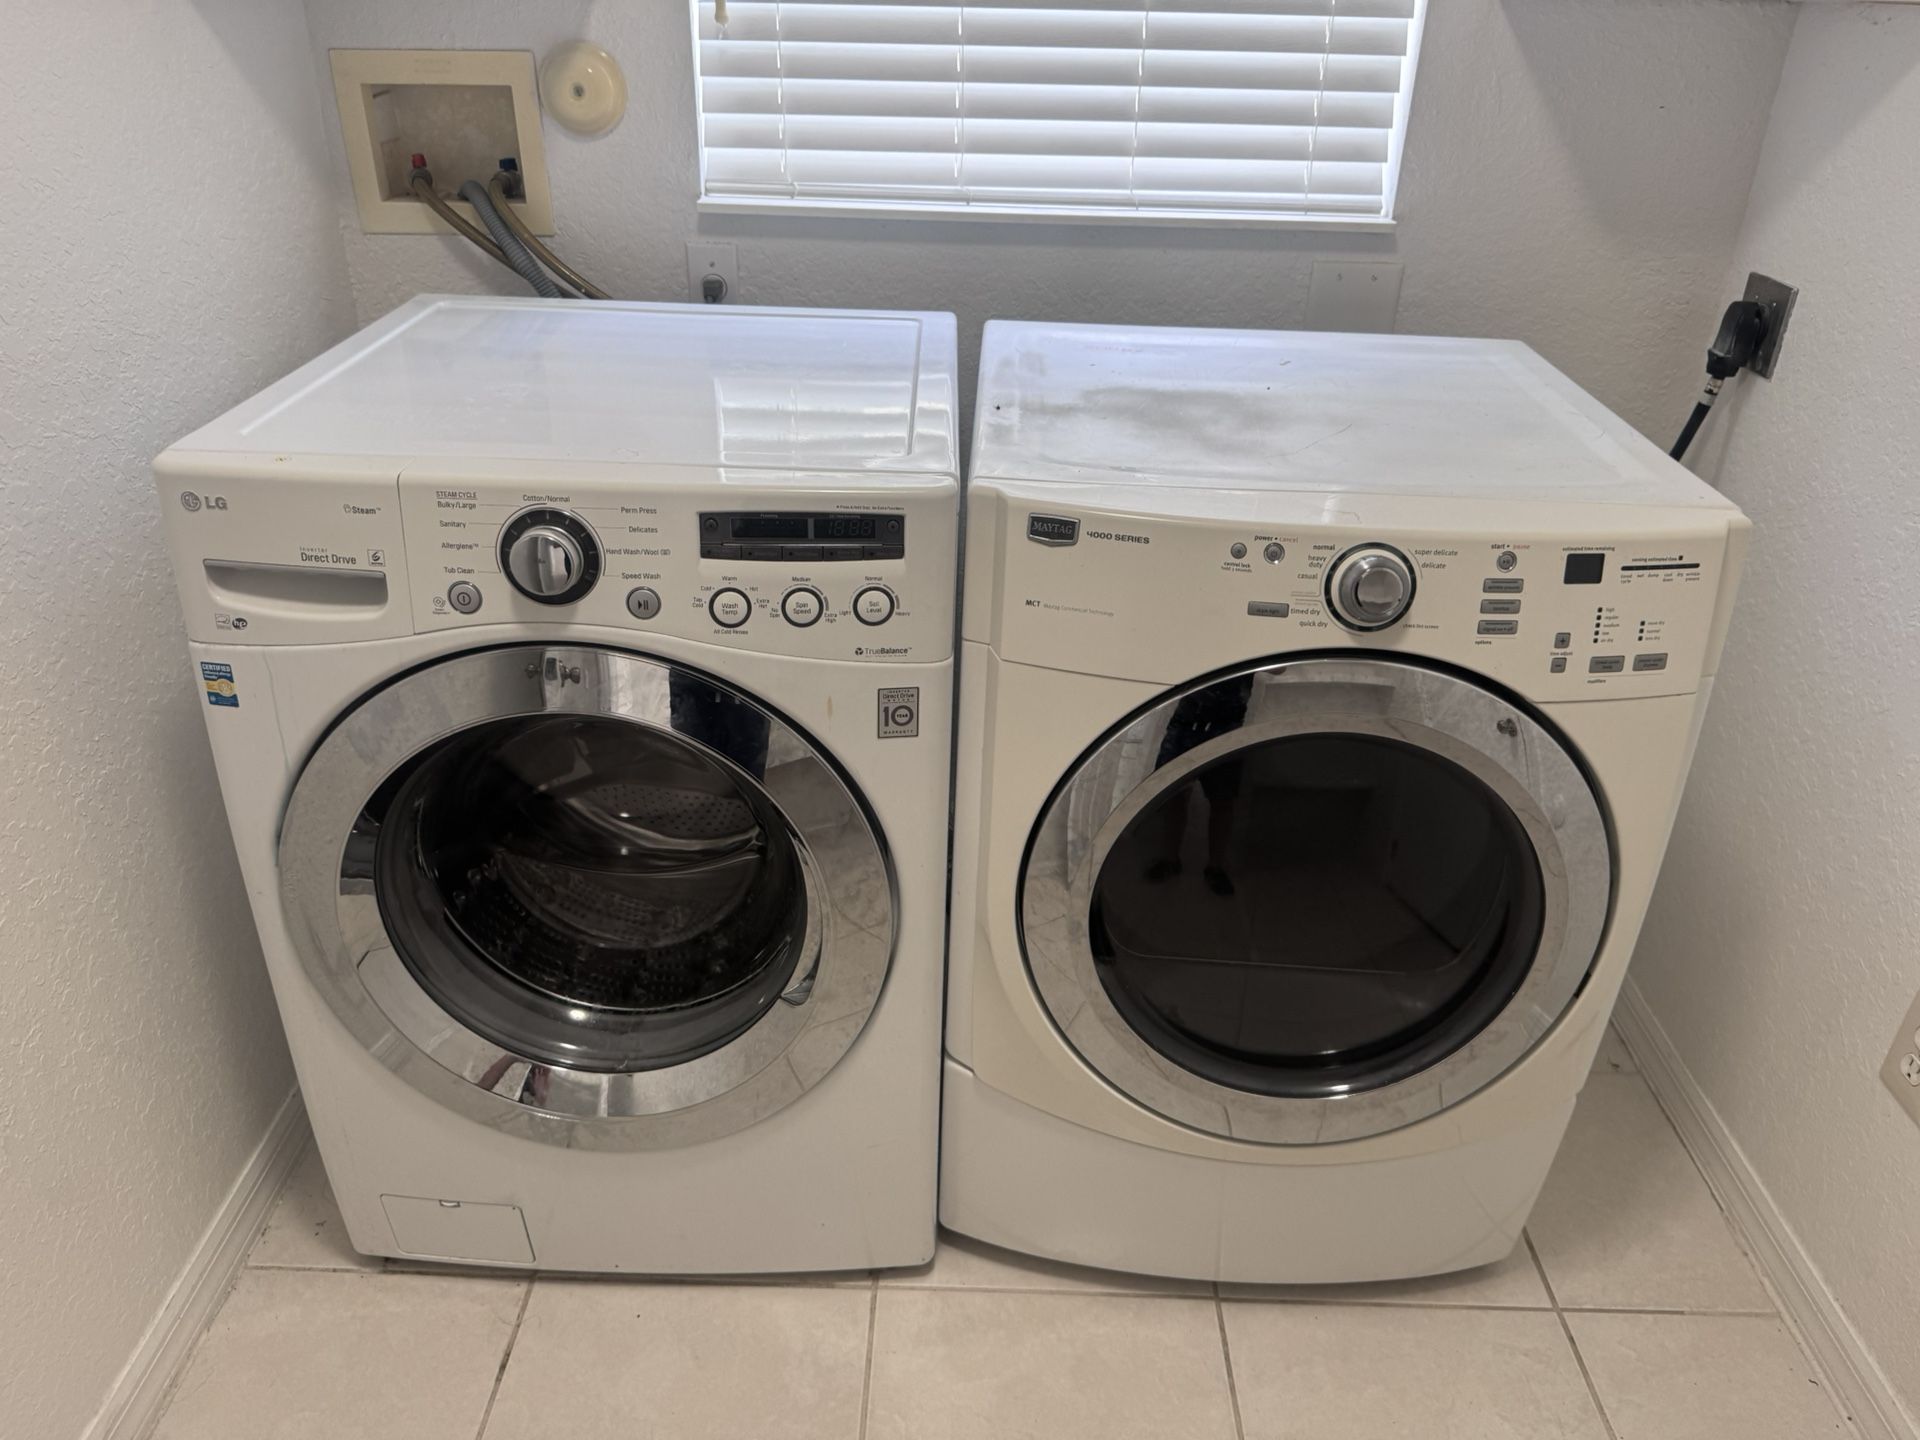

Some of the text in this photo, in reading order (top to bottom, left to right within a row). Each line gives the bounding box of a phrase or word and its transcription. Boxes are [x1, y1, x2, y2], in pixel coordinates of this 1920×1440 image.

[459, 491, 477, 499] CYCLE
[522, 494, 571, 503] Cotton/Normal
[204, 496, 228, 510] LG
[437, 500, 477, 510] Bulky/Large
[440, 519, 466, 529] Sanitary
[1031, 521, 1073, 535] MAYTAG
[628, 526, 658, 534] Delicates
[1086, 530, 1150, 544] 4000 SERIES
[300, 552, 357, 565] Direct Drive
[444, 566, 475, 574] Tub Clean
[621, 572, 661, 580] Speed Wash
[1025, 599, 1041, 608] MCT
[882, 704, 914, 727] 10
